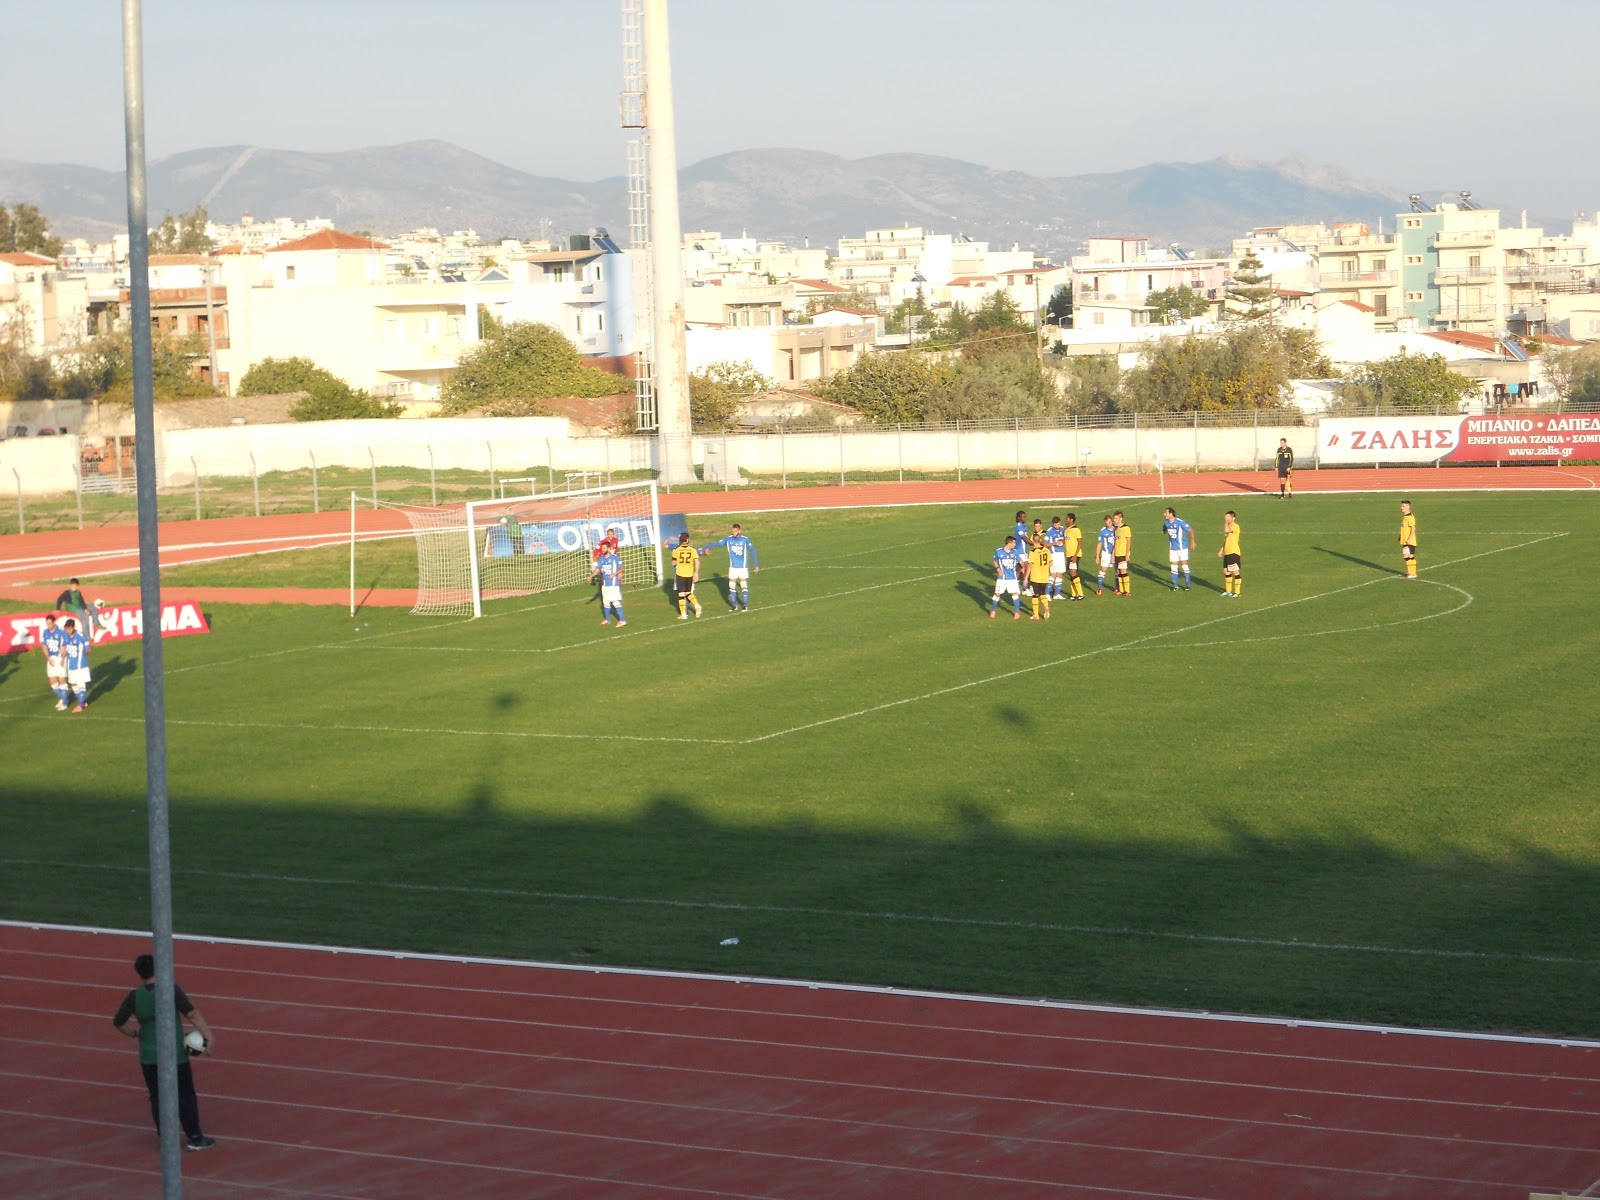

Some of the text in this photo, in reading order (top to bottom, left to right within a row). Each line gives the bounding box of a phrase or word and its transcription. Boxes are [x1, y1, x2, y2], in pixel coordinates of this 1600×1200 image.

[1467, 419, 1533, 433] ΜΠΑΝΙΟ
[1350, 430, 1454, 450] ΖΑΛΗΣ
[1467, 435, 1528, 445] ΕΝΕΡΓΕΙΑΚΑ
[1529, 435, 1564, 444] ΤΖΑΚΙΑ
[1508, 445, 1574, 457] www.zalis.gr
[679, 552, 692, 564] 52
[1039, 553, 1048, 566] 19
